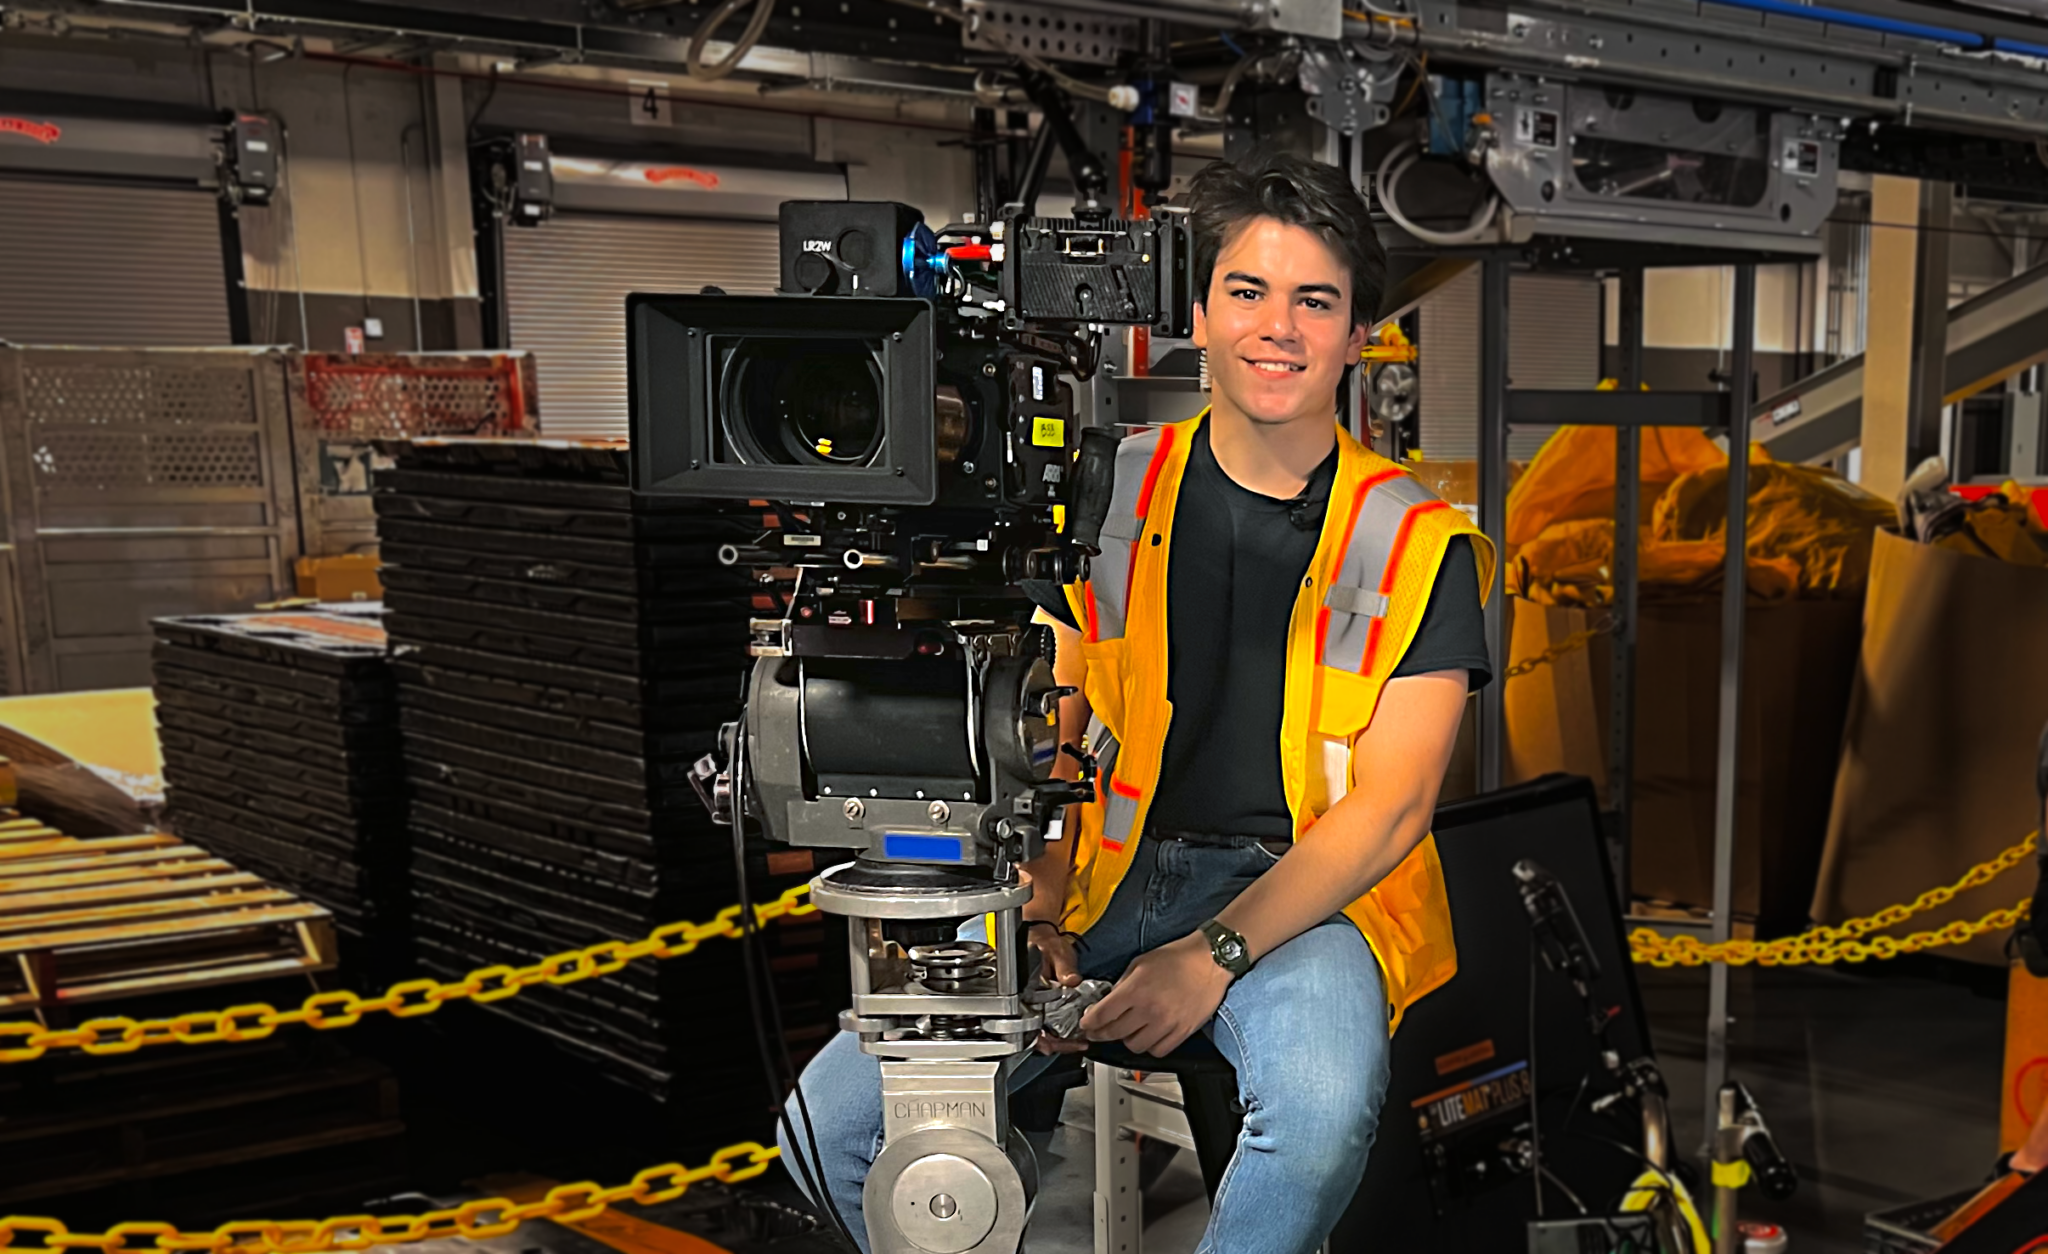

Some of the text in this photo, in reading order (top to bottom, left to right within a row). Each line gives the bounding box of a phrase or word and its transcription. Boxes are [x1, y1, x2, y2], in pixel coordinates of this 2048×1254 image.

[643, 87, 658, 120] 4
[803, 240, 832, 252] LR2W
[894, 1101, 985, 1119] CHAPMAN
